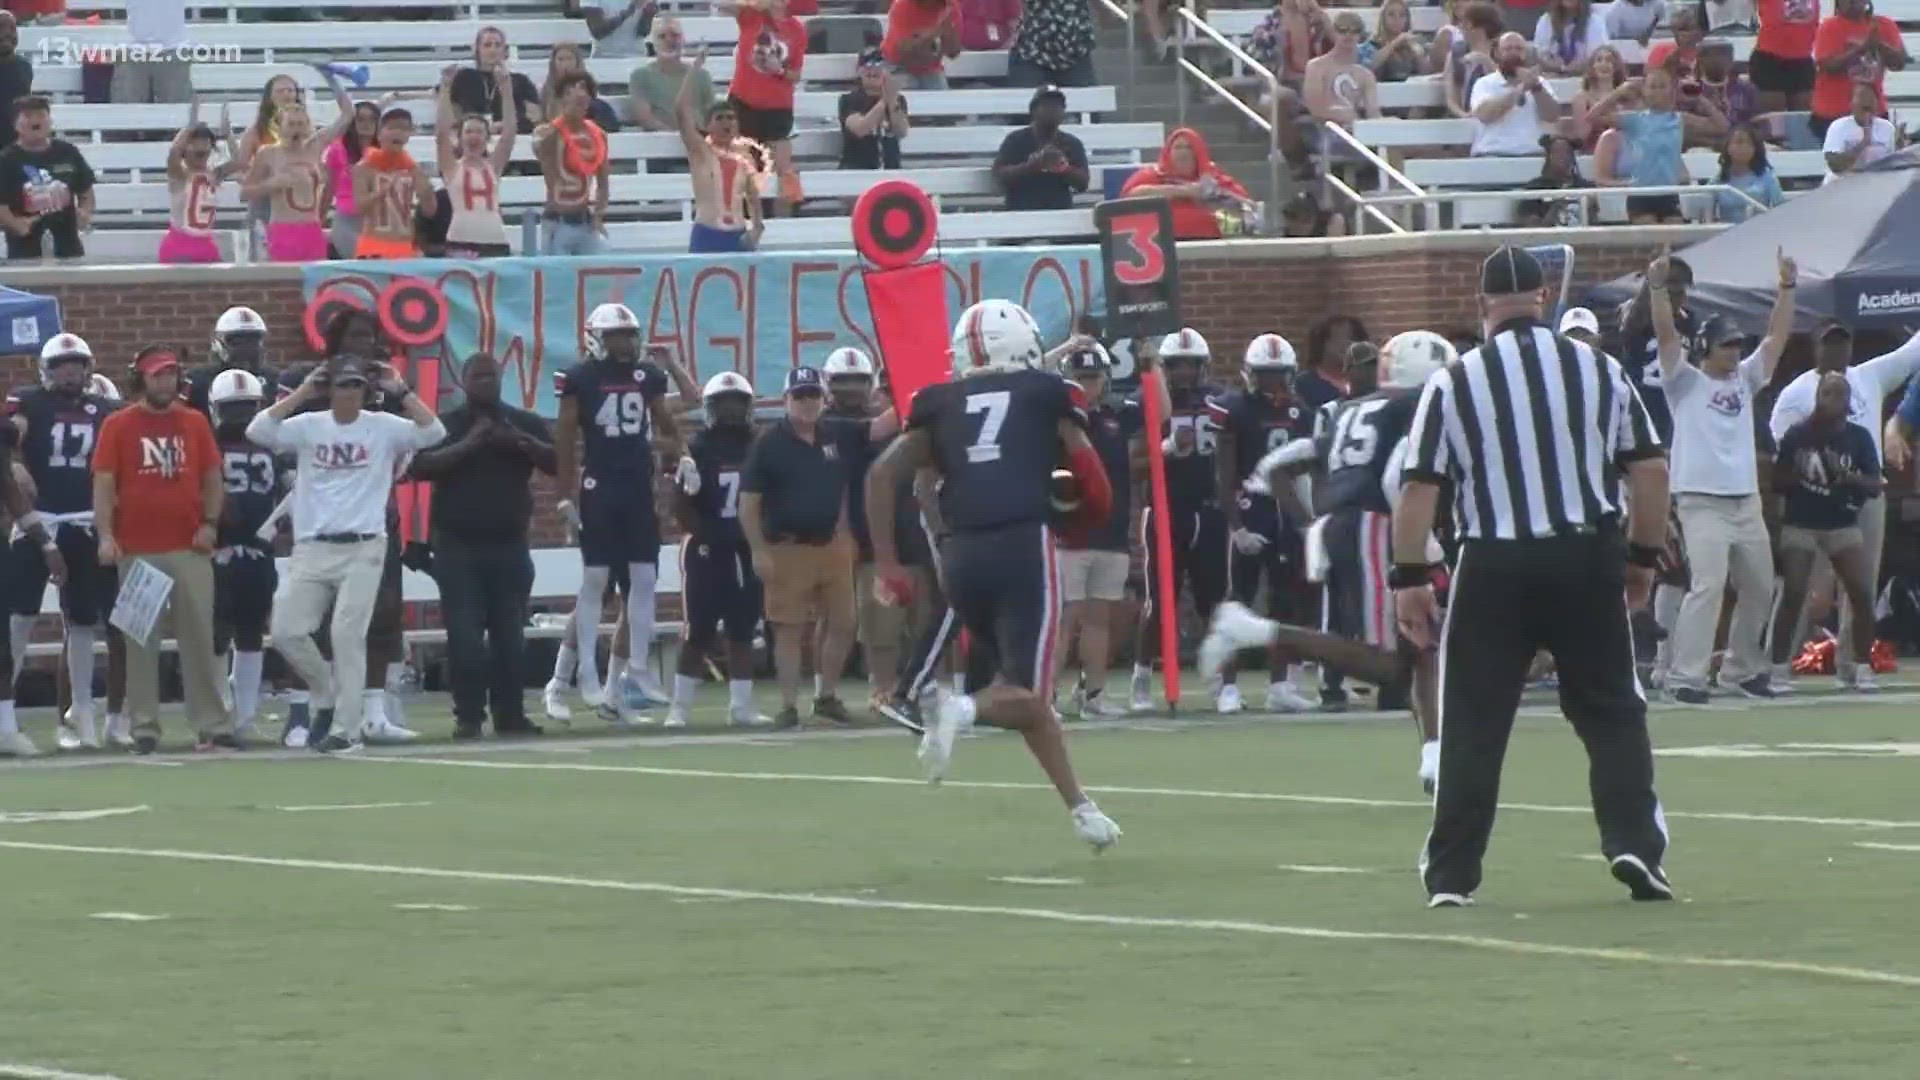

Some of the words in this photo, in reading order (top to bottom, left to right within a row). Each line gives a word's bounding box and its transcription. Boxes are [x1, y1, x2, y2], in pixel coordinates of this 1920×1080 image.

[463, 169, 494, 211] H
[1110, 212, 1165, 285] 3
[594, 391, 645, 438] 49
[965, 390, 1011, 463] 7
[1327, 399, 1390, 474] 15
[48, 421, 94, 469] 17
[223, 451, 274, 494] 53
[718, 472, 740, 518] 7
